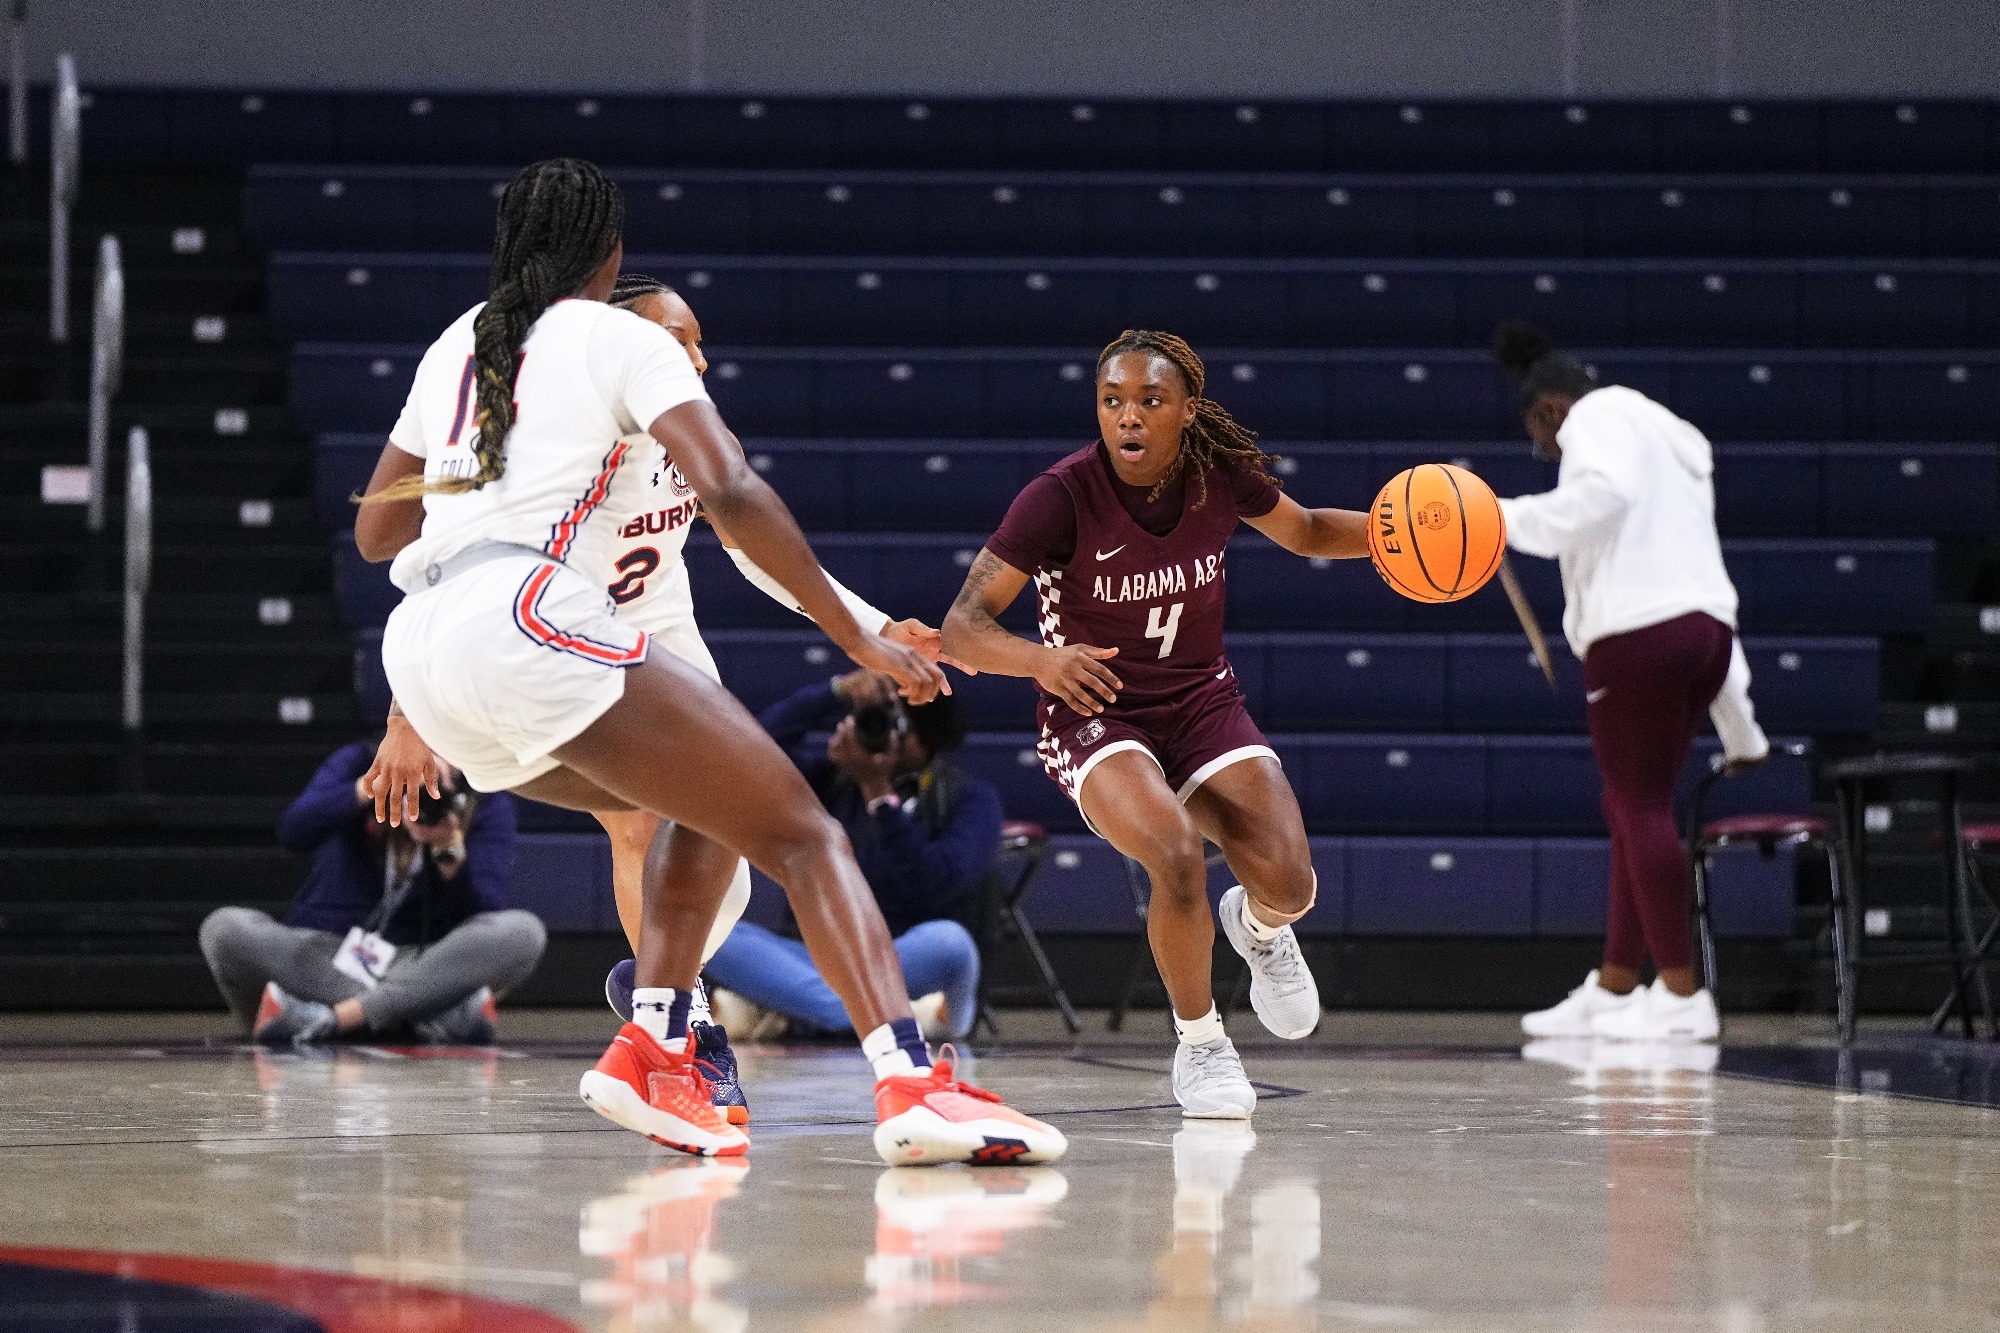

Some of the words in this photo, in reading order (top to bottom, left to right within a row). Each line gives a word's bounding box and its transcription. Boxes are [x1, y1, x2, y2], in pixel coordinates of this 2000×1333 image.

[618, 496, 699, 538] BURN
[1380, 502, 1402, 554] EVO
[608, 546, 660, 605] 2
[1093, 564, 1186, 603] ALABAMA
[1145, 602, 1184, 659] 4
